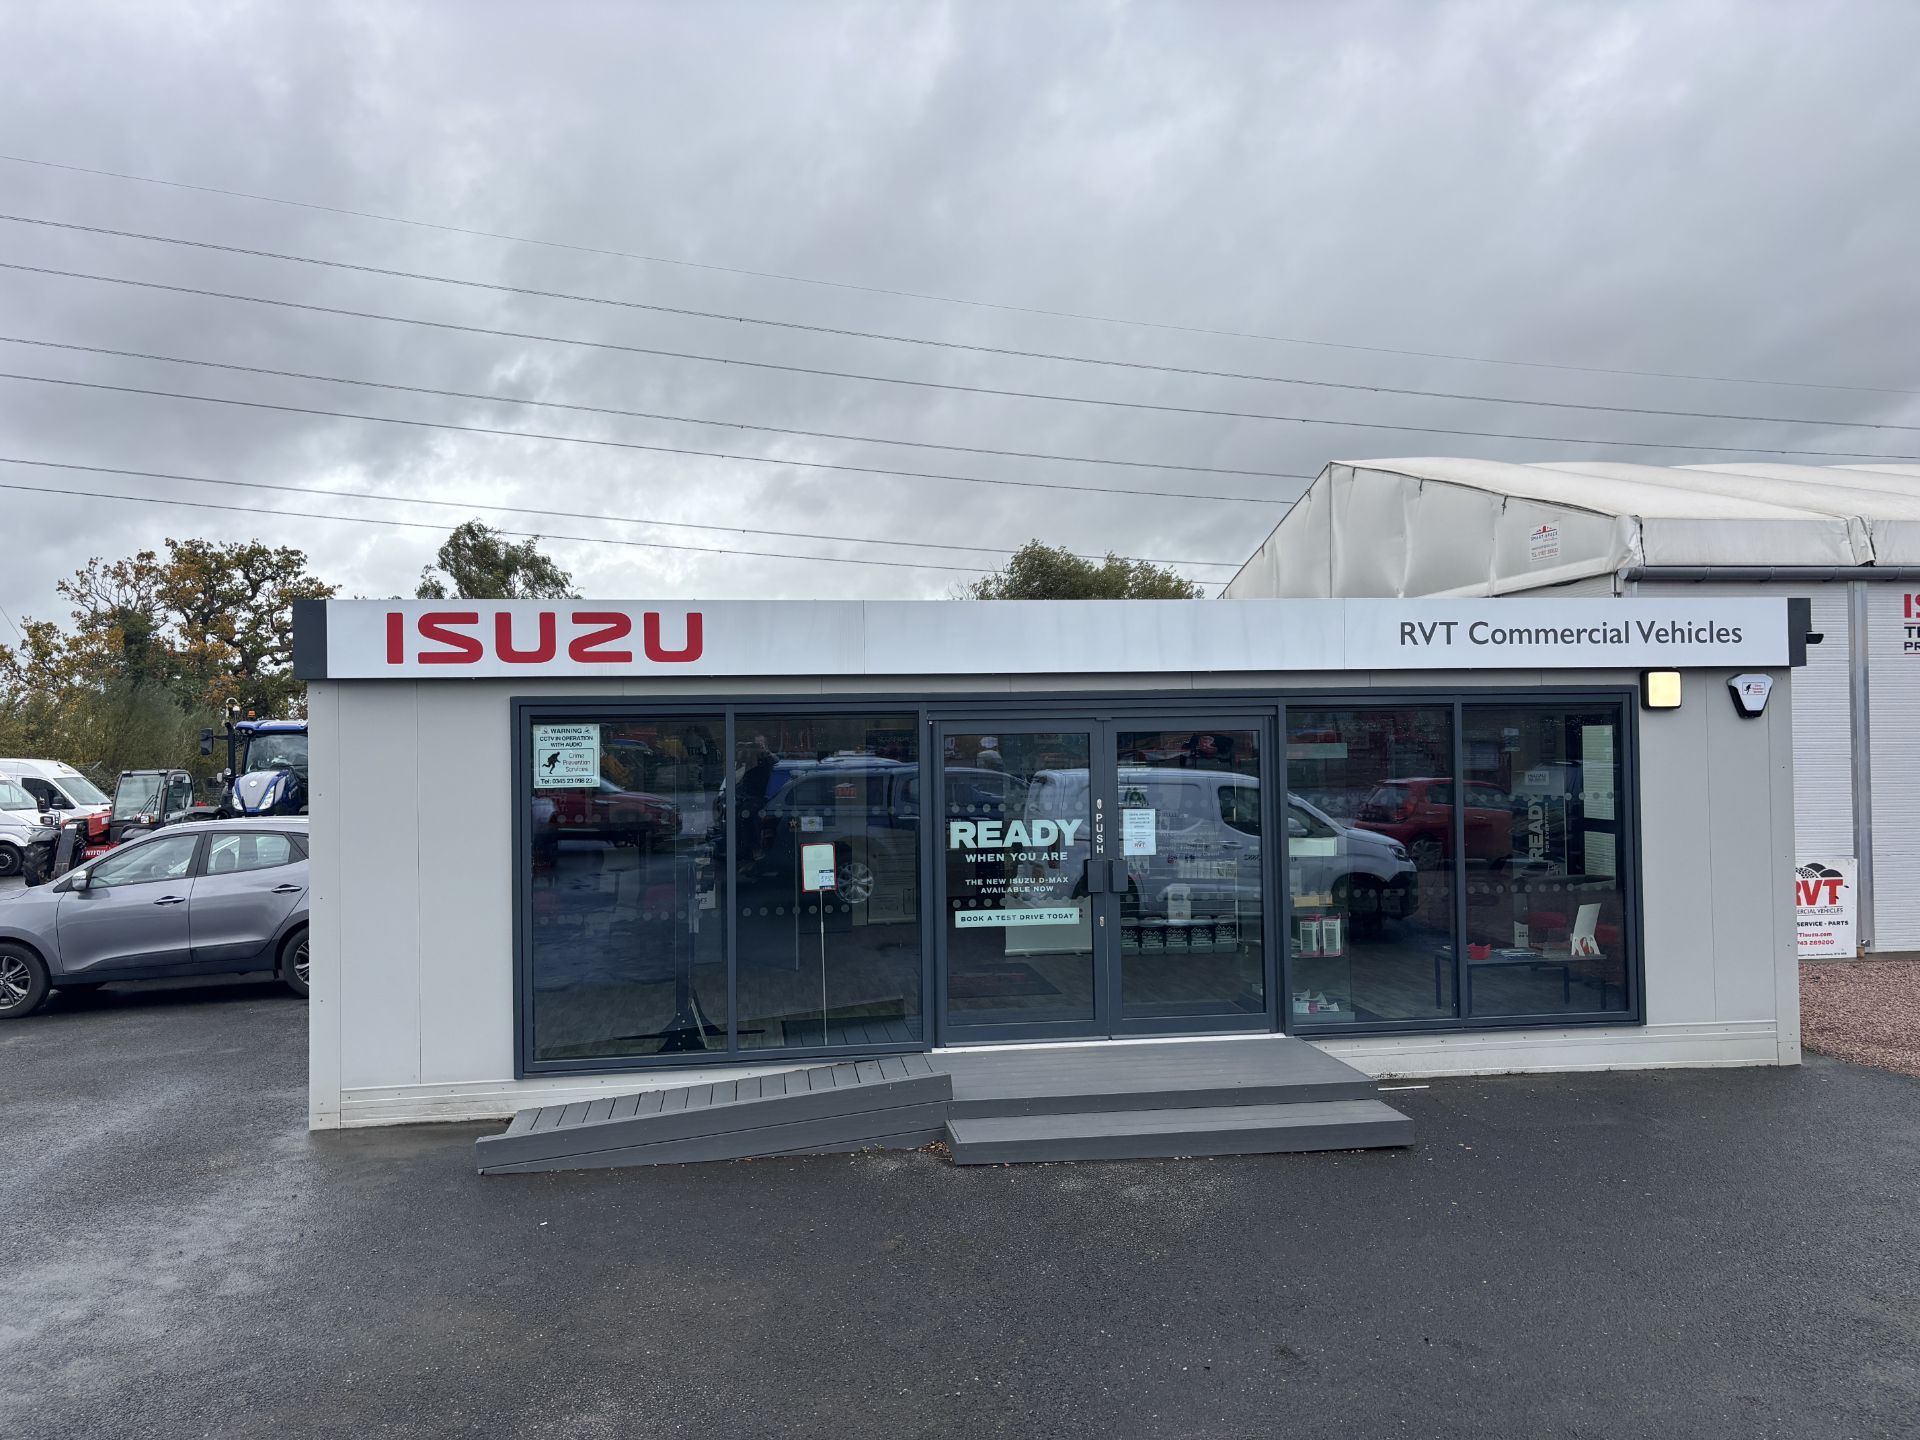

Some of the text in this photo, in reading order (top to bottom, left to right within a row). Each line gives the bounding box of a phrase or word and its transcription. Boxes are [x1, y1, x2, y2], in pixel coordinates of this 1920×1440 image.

[387, 612, 703, 664] ISUZU
[1400, 621, 1742, 645] RVT Commercial Vehicles
[950, 819, 1083, 848] READY
[1096, 813, 1104, 854] PUSH
[1528, 794, 1544, 862] READY
[965, 852, 1068, 862] WHEN YOU ARE
